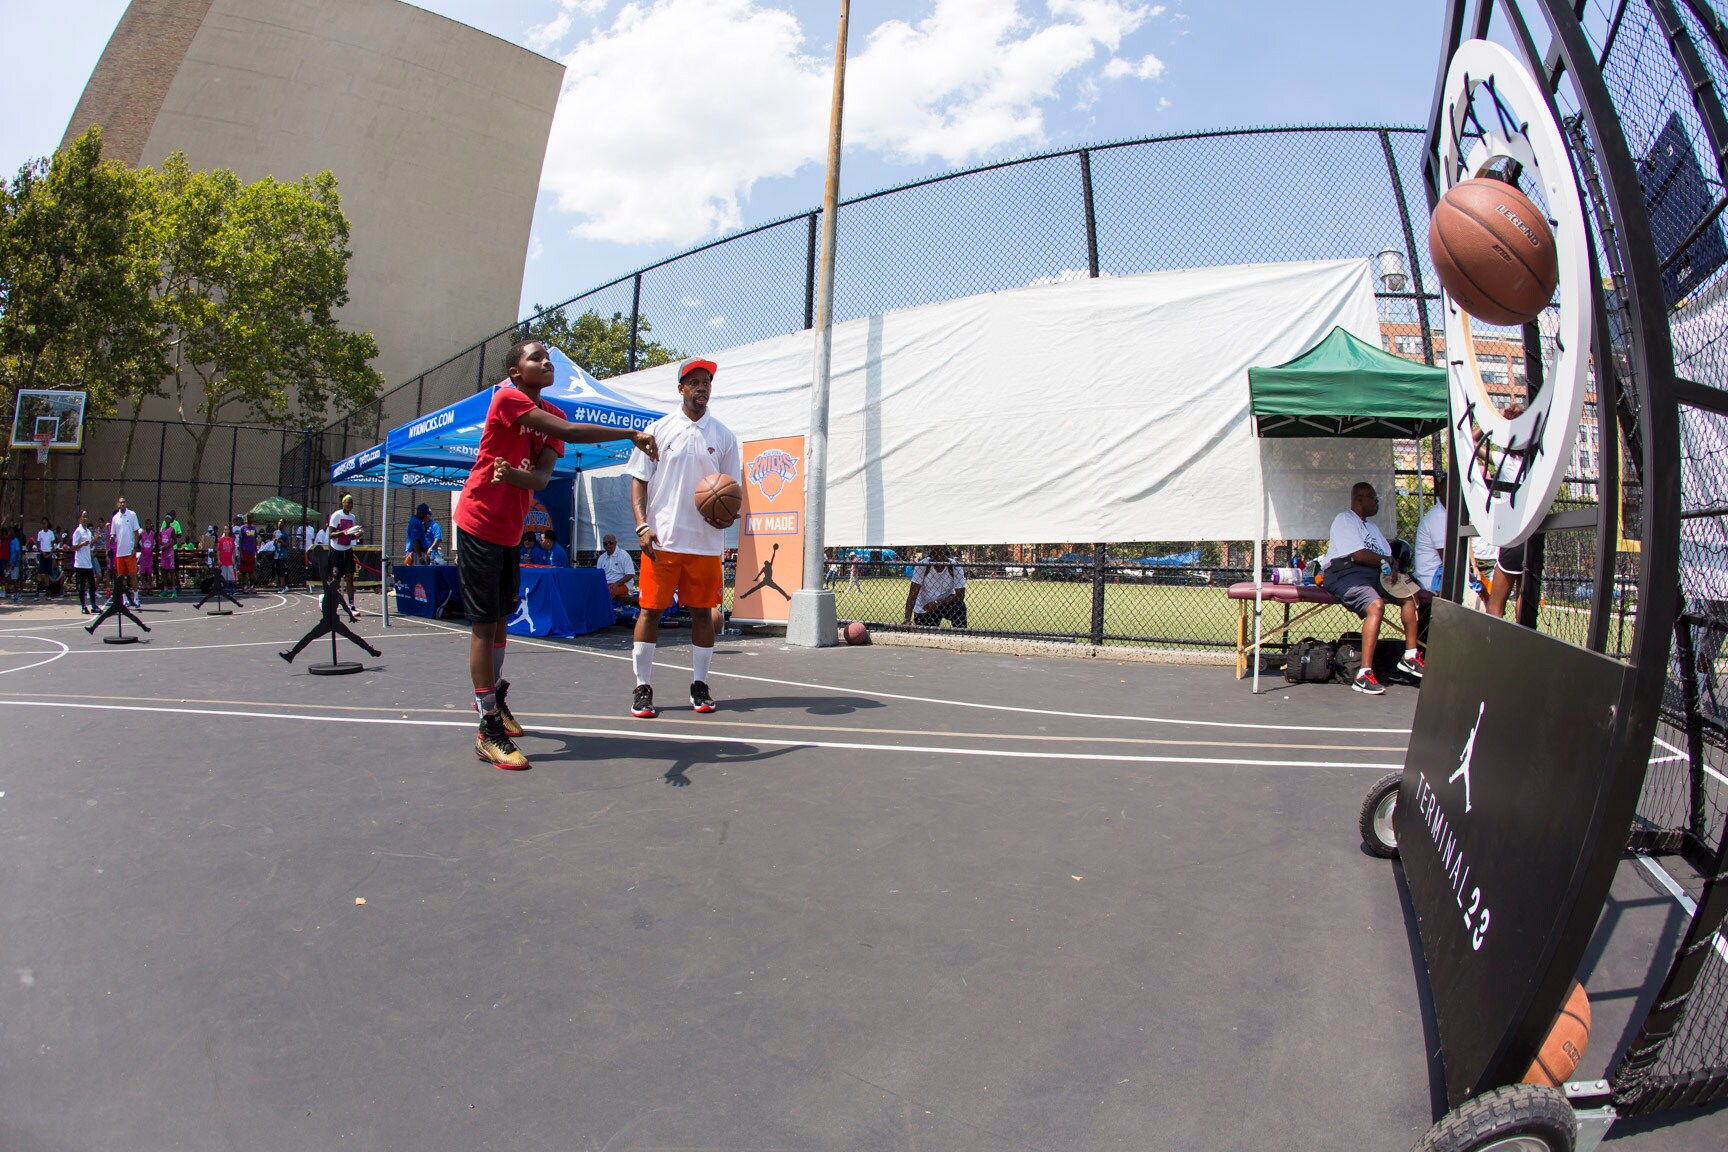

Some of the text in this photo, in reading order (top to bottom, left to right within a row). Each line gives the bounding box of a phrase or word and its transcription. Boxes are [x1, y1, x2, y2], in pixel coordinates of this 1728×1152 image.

[1496, 205, 1540, 247] LEGEND
[408, 410, 455, 438] NYKNICKS.COM
[748, 453, 797, 480] KNICKS
[748, 516, 795, 532] NY MADE
